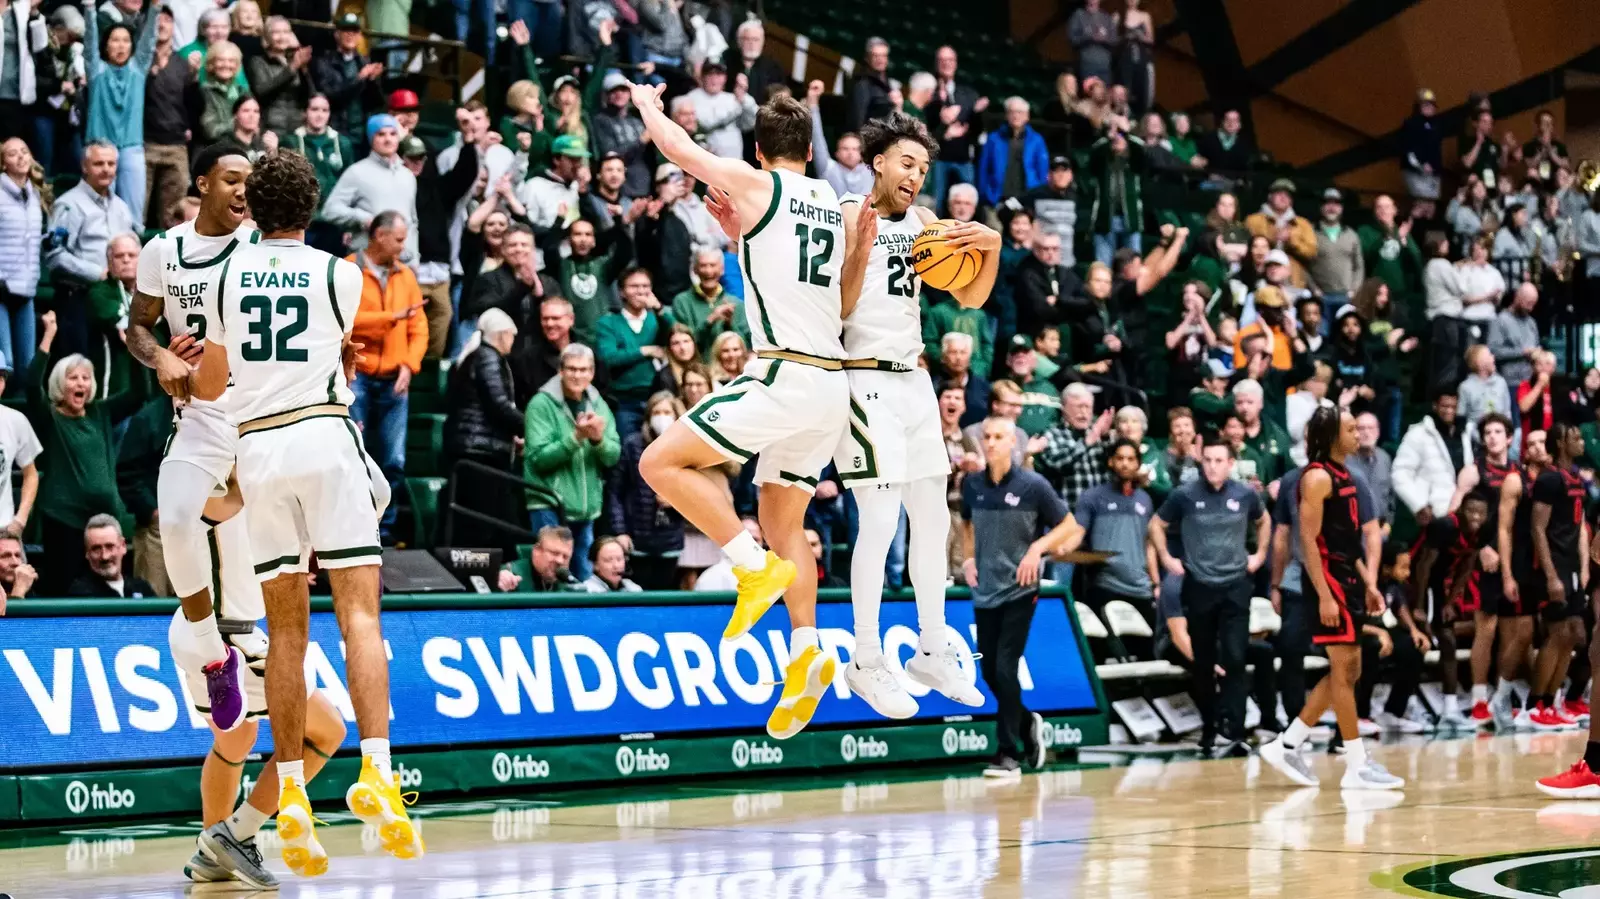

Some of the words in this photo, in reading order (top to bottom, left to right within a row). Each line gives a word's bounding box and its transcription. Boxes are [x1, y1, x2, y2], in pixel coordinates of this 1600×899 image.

[790, 198, 842, 228] CARTIER
[874, 233, 918, 247] OLORA
[887, 244, 913, 254] STAT
[795, 223, 835, 288] 12
[167, 282, 208, 297] COLOR
[240, 272, 310, 288] EVANS
[887, 255, 916, 298] 23
[179, 297, 204, 309] STA
[240, 295, 309, 362] 32
[3, 645, 209, 735] VIS
[392, 762, 422, 787] bo
[91, 782, 135, 809] fnbo
